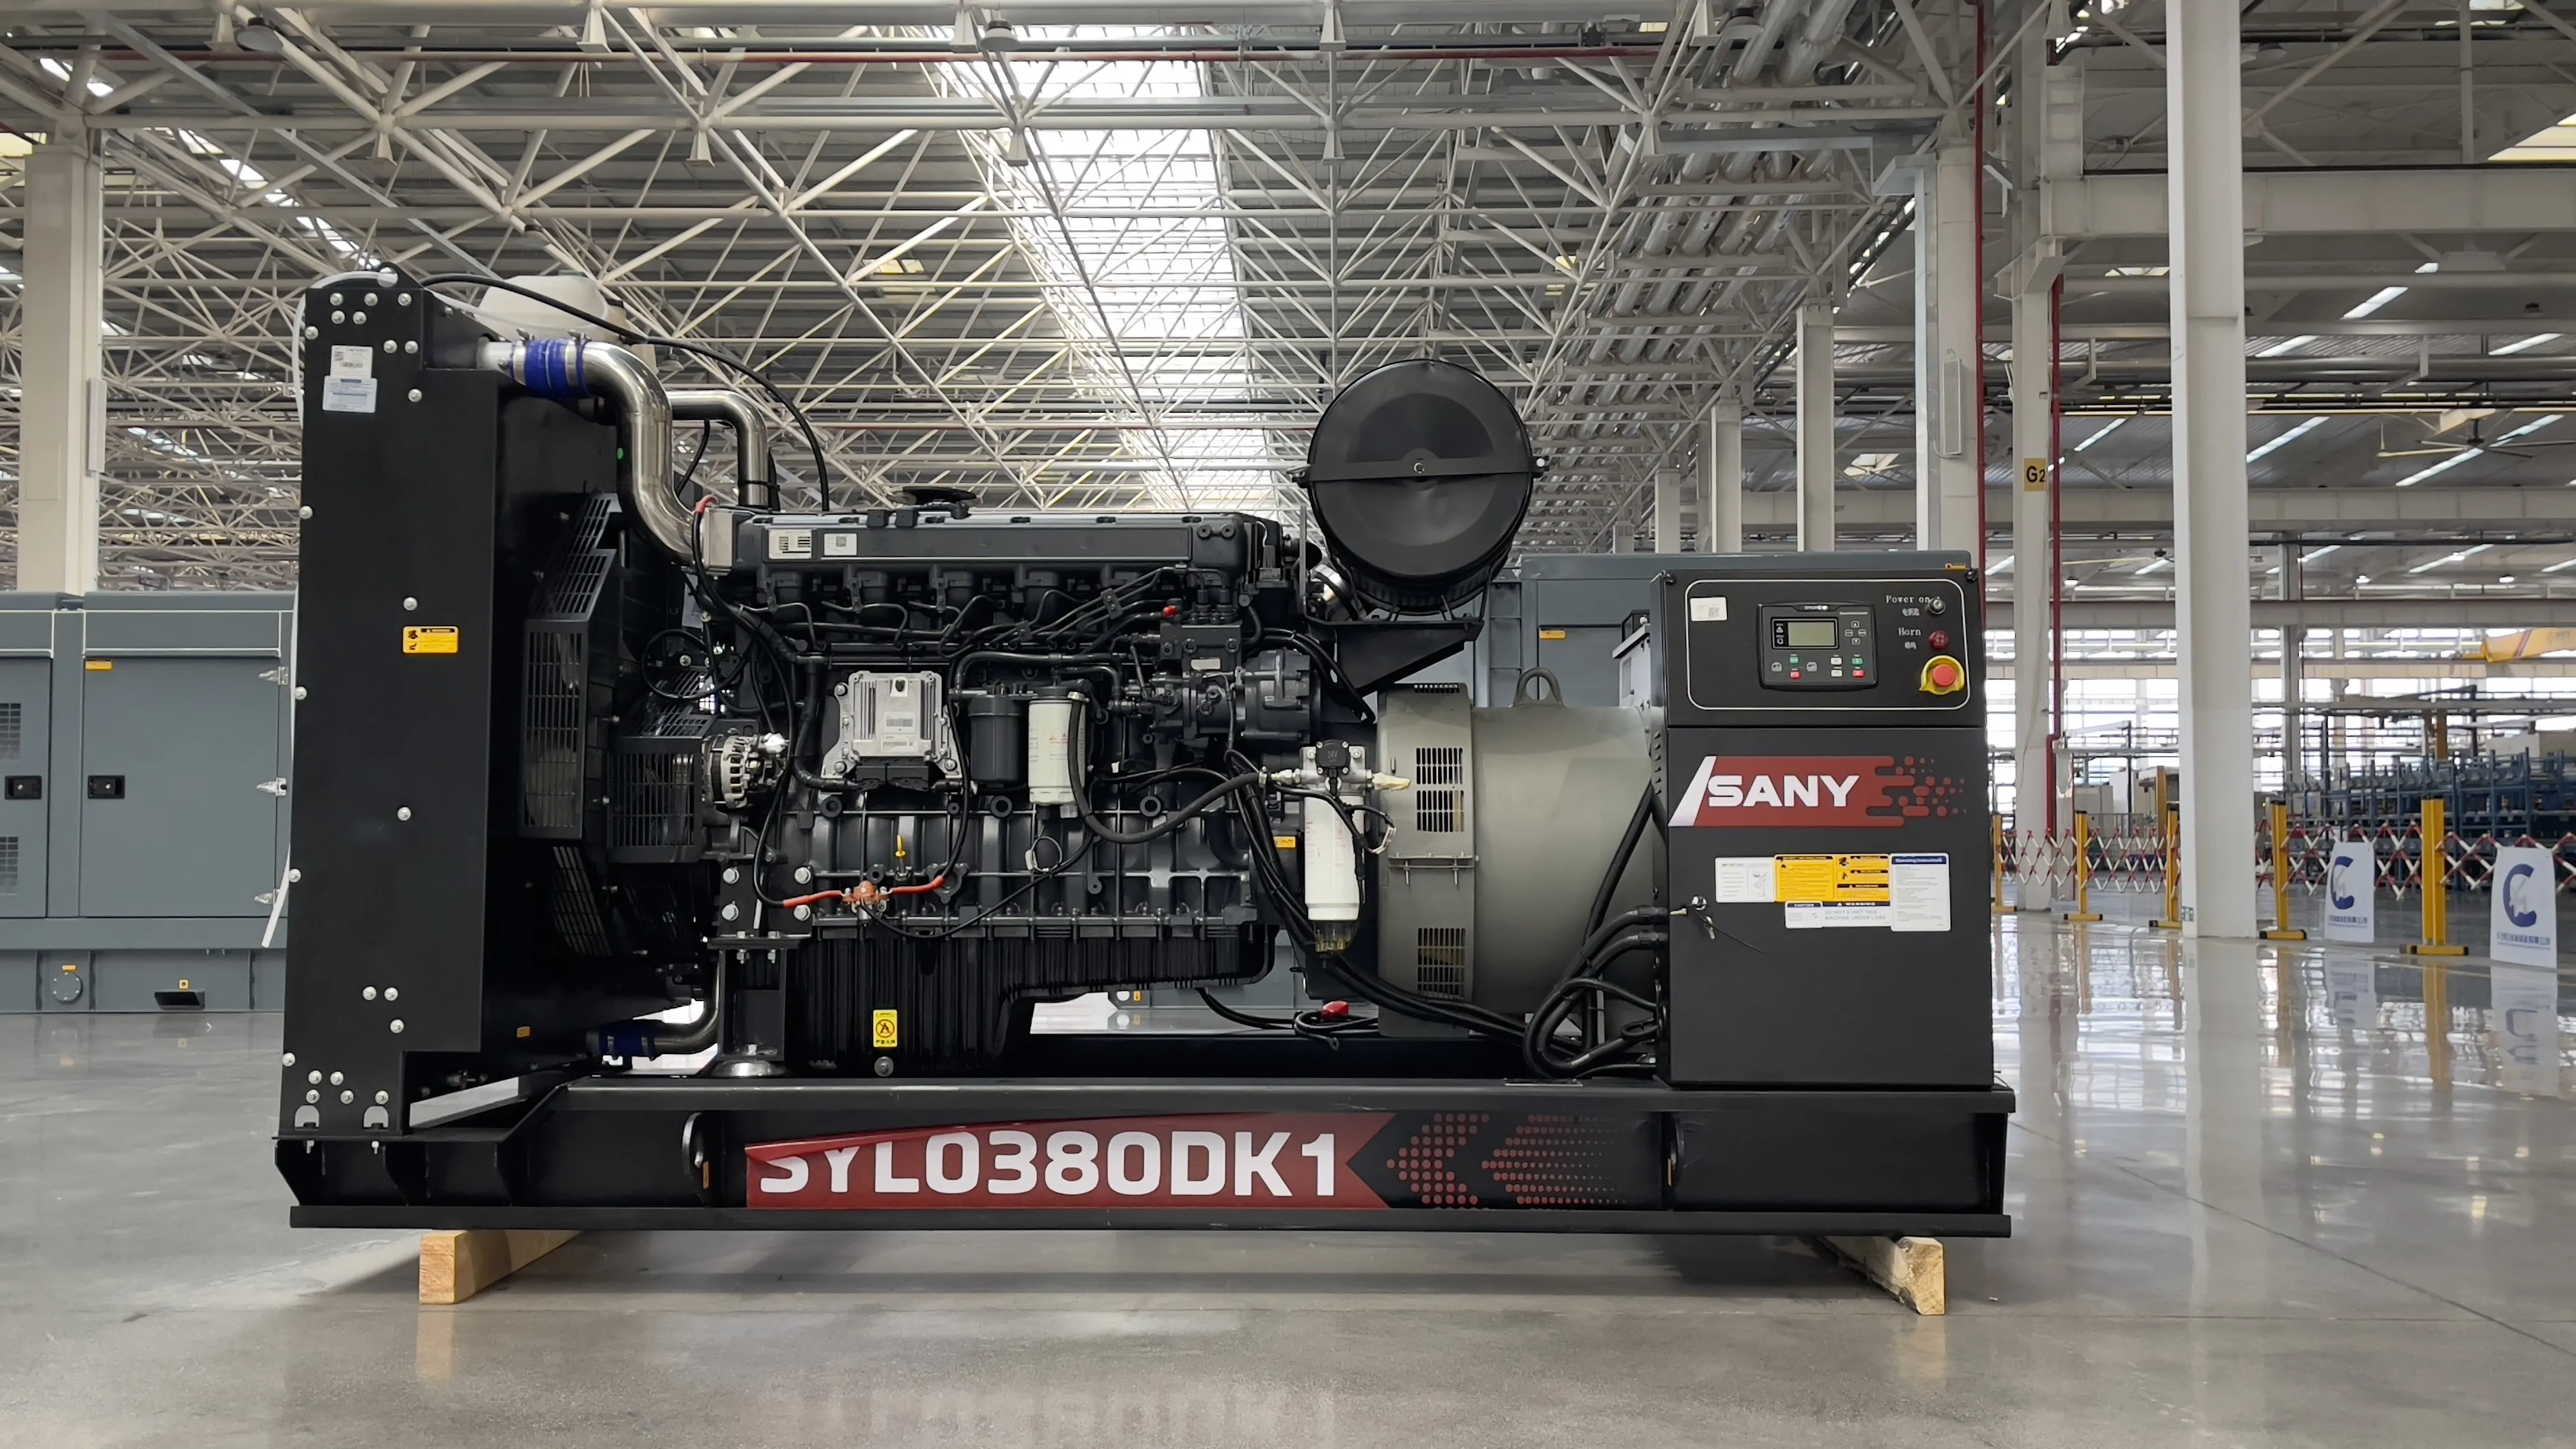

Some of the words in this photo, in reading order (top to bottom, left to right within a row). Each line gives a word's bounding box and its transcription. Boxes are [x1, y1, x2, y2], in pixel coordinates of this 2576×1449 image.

[2027, 465, 2046, 483] G2
[1886, 595, 1915, 604] Power
[1898, 627, 1921, 636] Horn
[1707, 775, 1860, 807] SANY
